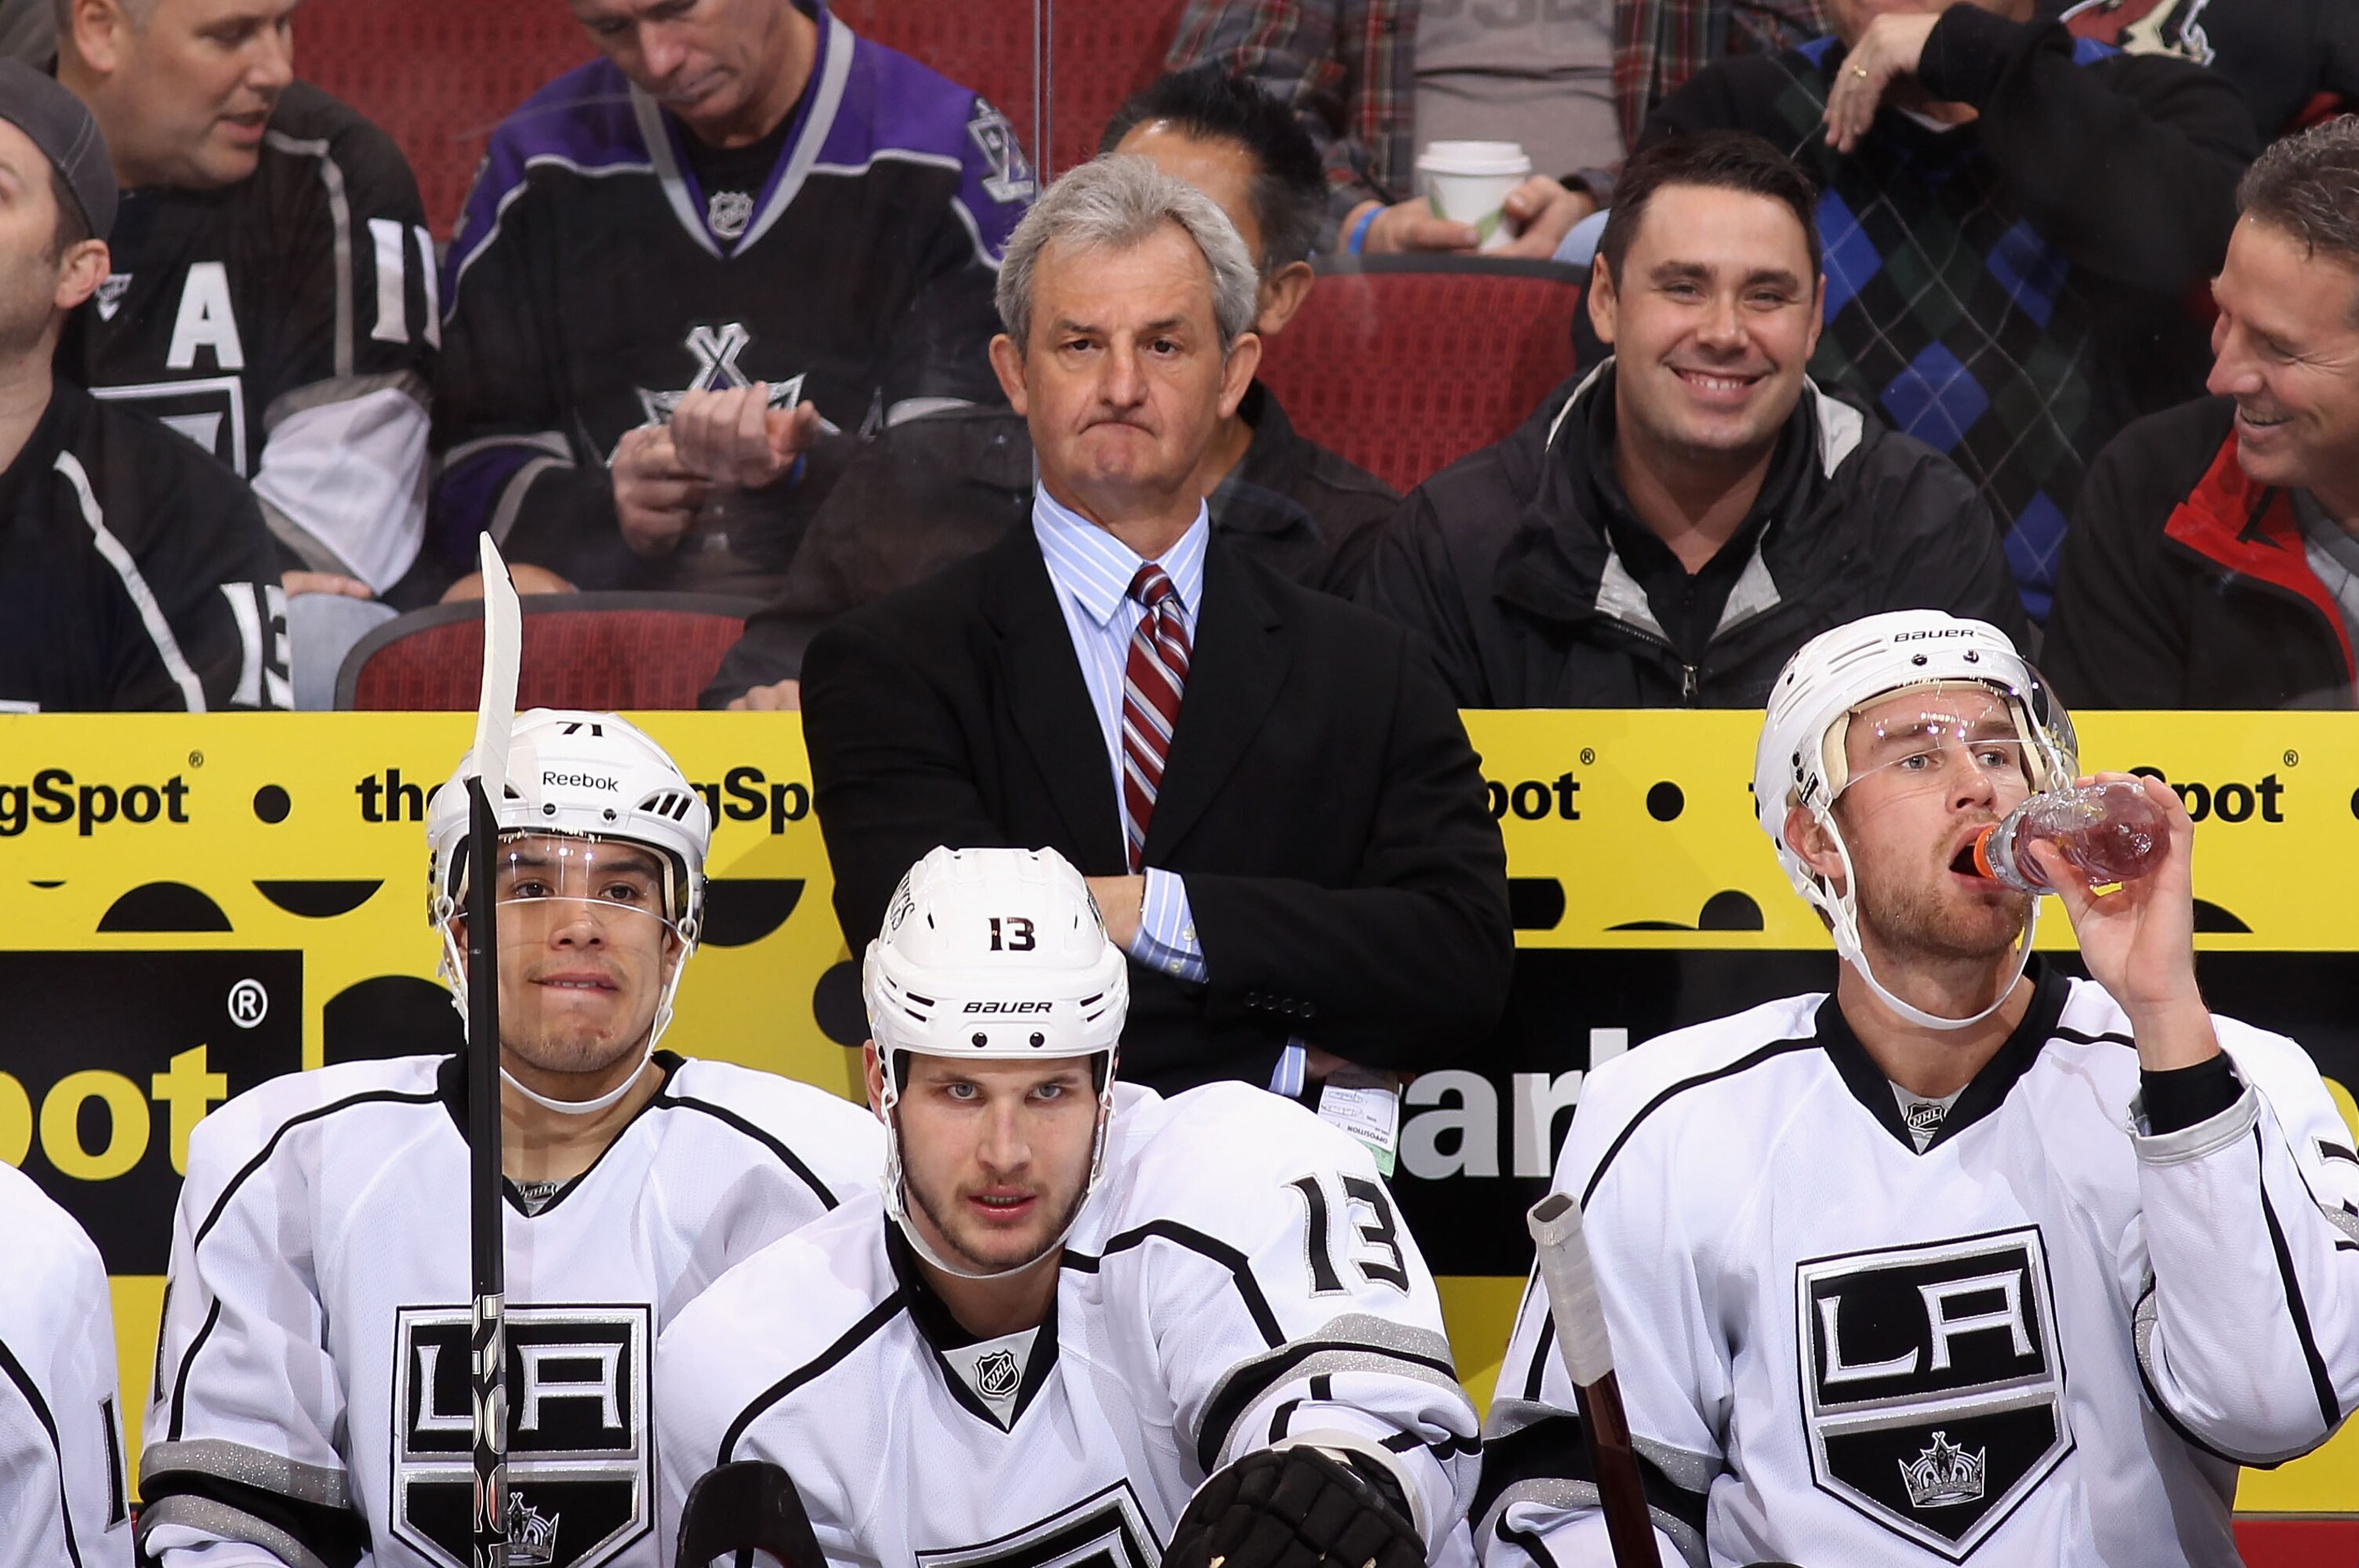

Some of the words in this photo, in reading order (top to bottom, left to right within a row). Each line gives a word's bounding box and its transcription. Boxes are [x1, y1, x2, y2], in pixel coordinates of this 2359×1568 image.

[166, 262, 244, 369] A
[555, 720, 604, 737] 71
[543, 771, 619, 793] Reebok
[988, 916, 1036, 951] 13
[1913, 1109, 1940, 1127] NHL
[1347, 1125, 1388, 1145] OPPOSITION
[1279, 1171, 1412, 1299] 13
[1816, 1269, 2037, 1385] LA
[415, 1341, 625, 1432] LA
[988, 1359, 1011, 1391] NHL
